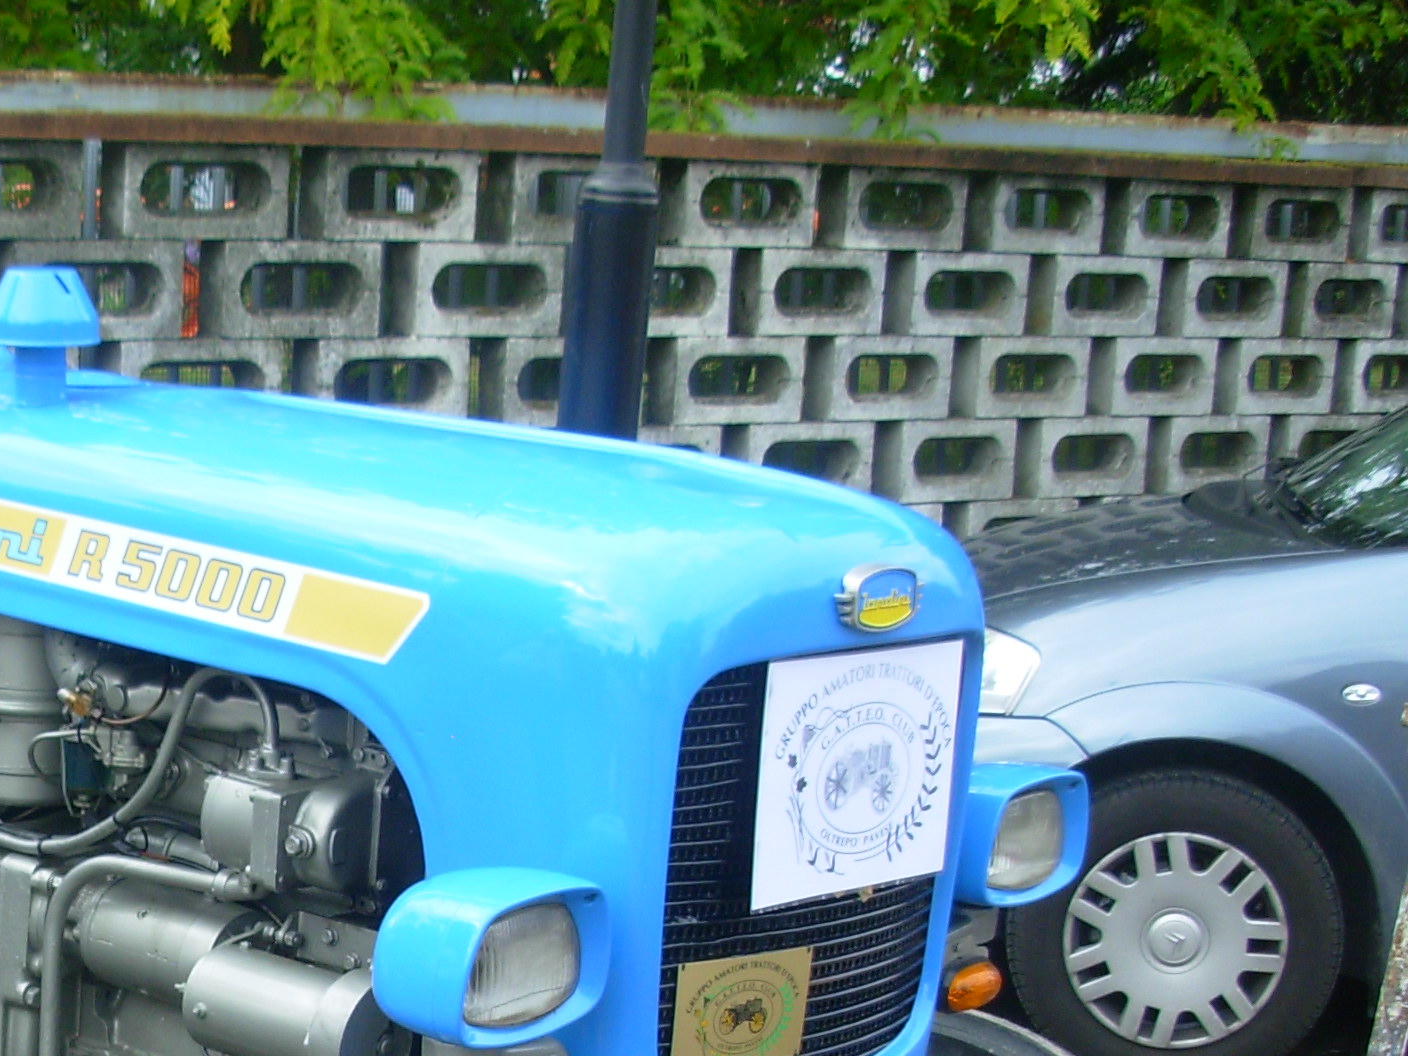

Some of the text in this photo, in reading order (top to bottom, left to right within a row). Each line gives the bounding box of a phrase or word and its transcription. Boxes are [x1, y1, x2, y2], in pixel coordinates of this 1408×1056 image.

[67, 529, 111, 582] R
[115, 539, 286, 623] 5000
[775, 693, 818, 760] GRUPPO
[822, 663, 876, 700] AMATORI
[878, 662, 925, 692] TRATTORI
[891, 713, 915, 745] CLUB
